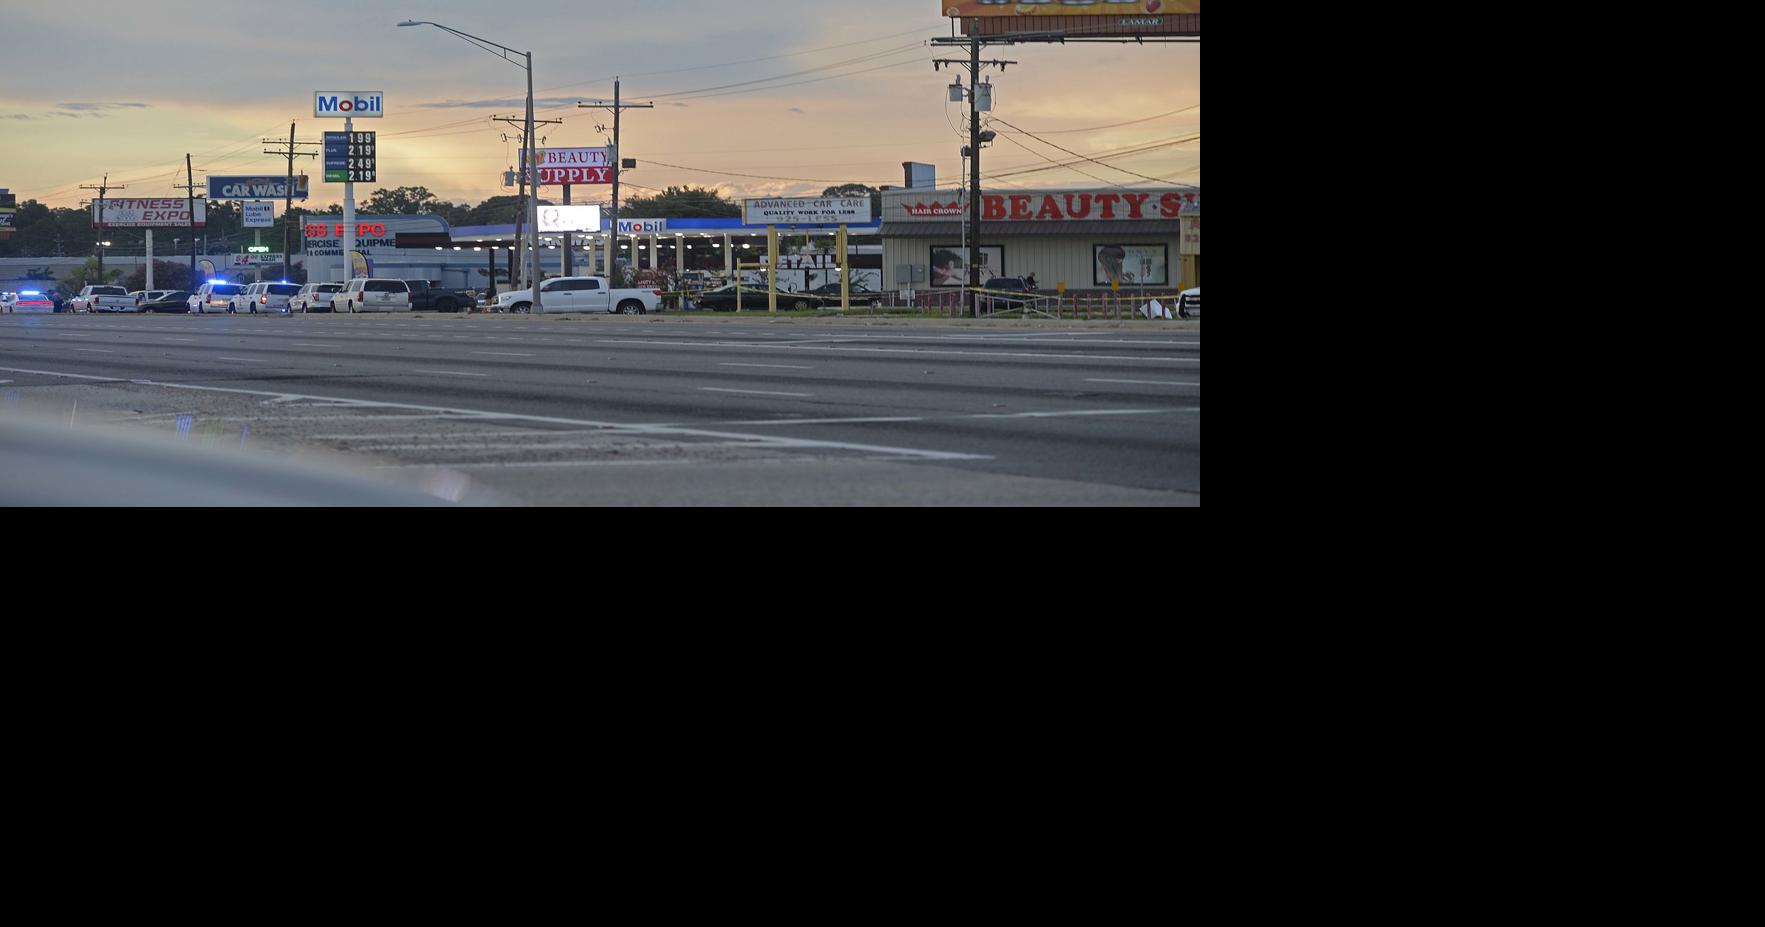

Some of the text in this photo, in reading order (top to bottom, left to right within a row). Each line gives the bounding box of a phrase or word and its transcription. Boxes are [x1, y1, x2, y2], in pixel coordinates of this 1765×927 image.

[318, 96, 380, 112] Mobil
[548, 152, 608, 163] BEAUTY
[222, 185, 250, 196] CAR
[108, 200, 184, 209] FITNESS
[754, 200, 804, 208] ADVANCED
[982, 193, 1150, 220] BEAUTY
[143, 211, 192, 220] EXPO
[334, 223, 385, 237] EPO
[619, 221, 662, 232] Mobil
[354, 239, 396, 247] QUIPME
